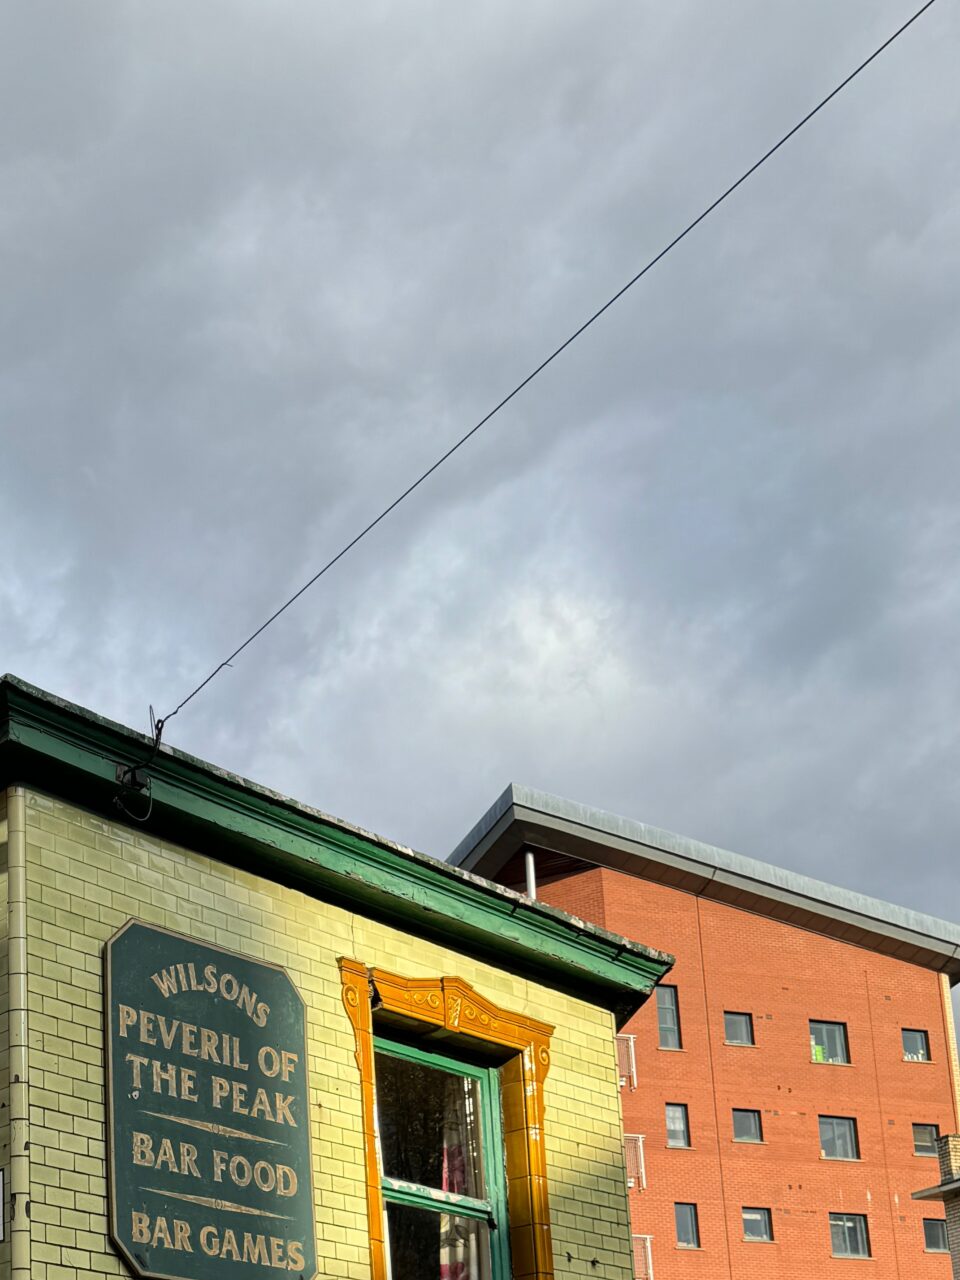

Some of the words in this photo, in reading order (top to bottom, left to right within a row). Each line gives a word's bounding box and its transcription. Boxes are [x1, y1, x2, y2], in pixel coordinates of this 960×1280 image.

[151, 962, 270, 1028] WILSONS
[118, 1003, 249, 1071] PEVERIL
[257, 1045, 298, 1082] OF
[125, 1052, 198, 1102] THE
[211, 1075, 298, 1127] PEAK
[132, 1131, 198, 1178] BAR
[213, 1149, 298, 1197] FOOD
[131, 1211, 194, 1254] BAR
[199, 1224, 306, 1271] GAMES
